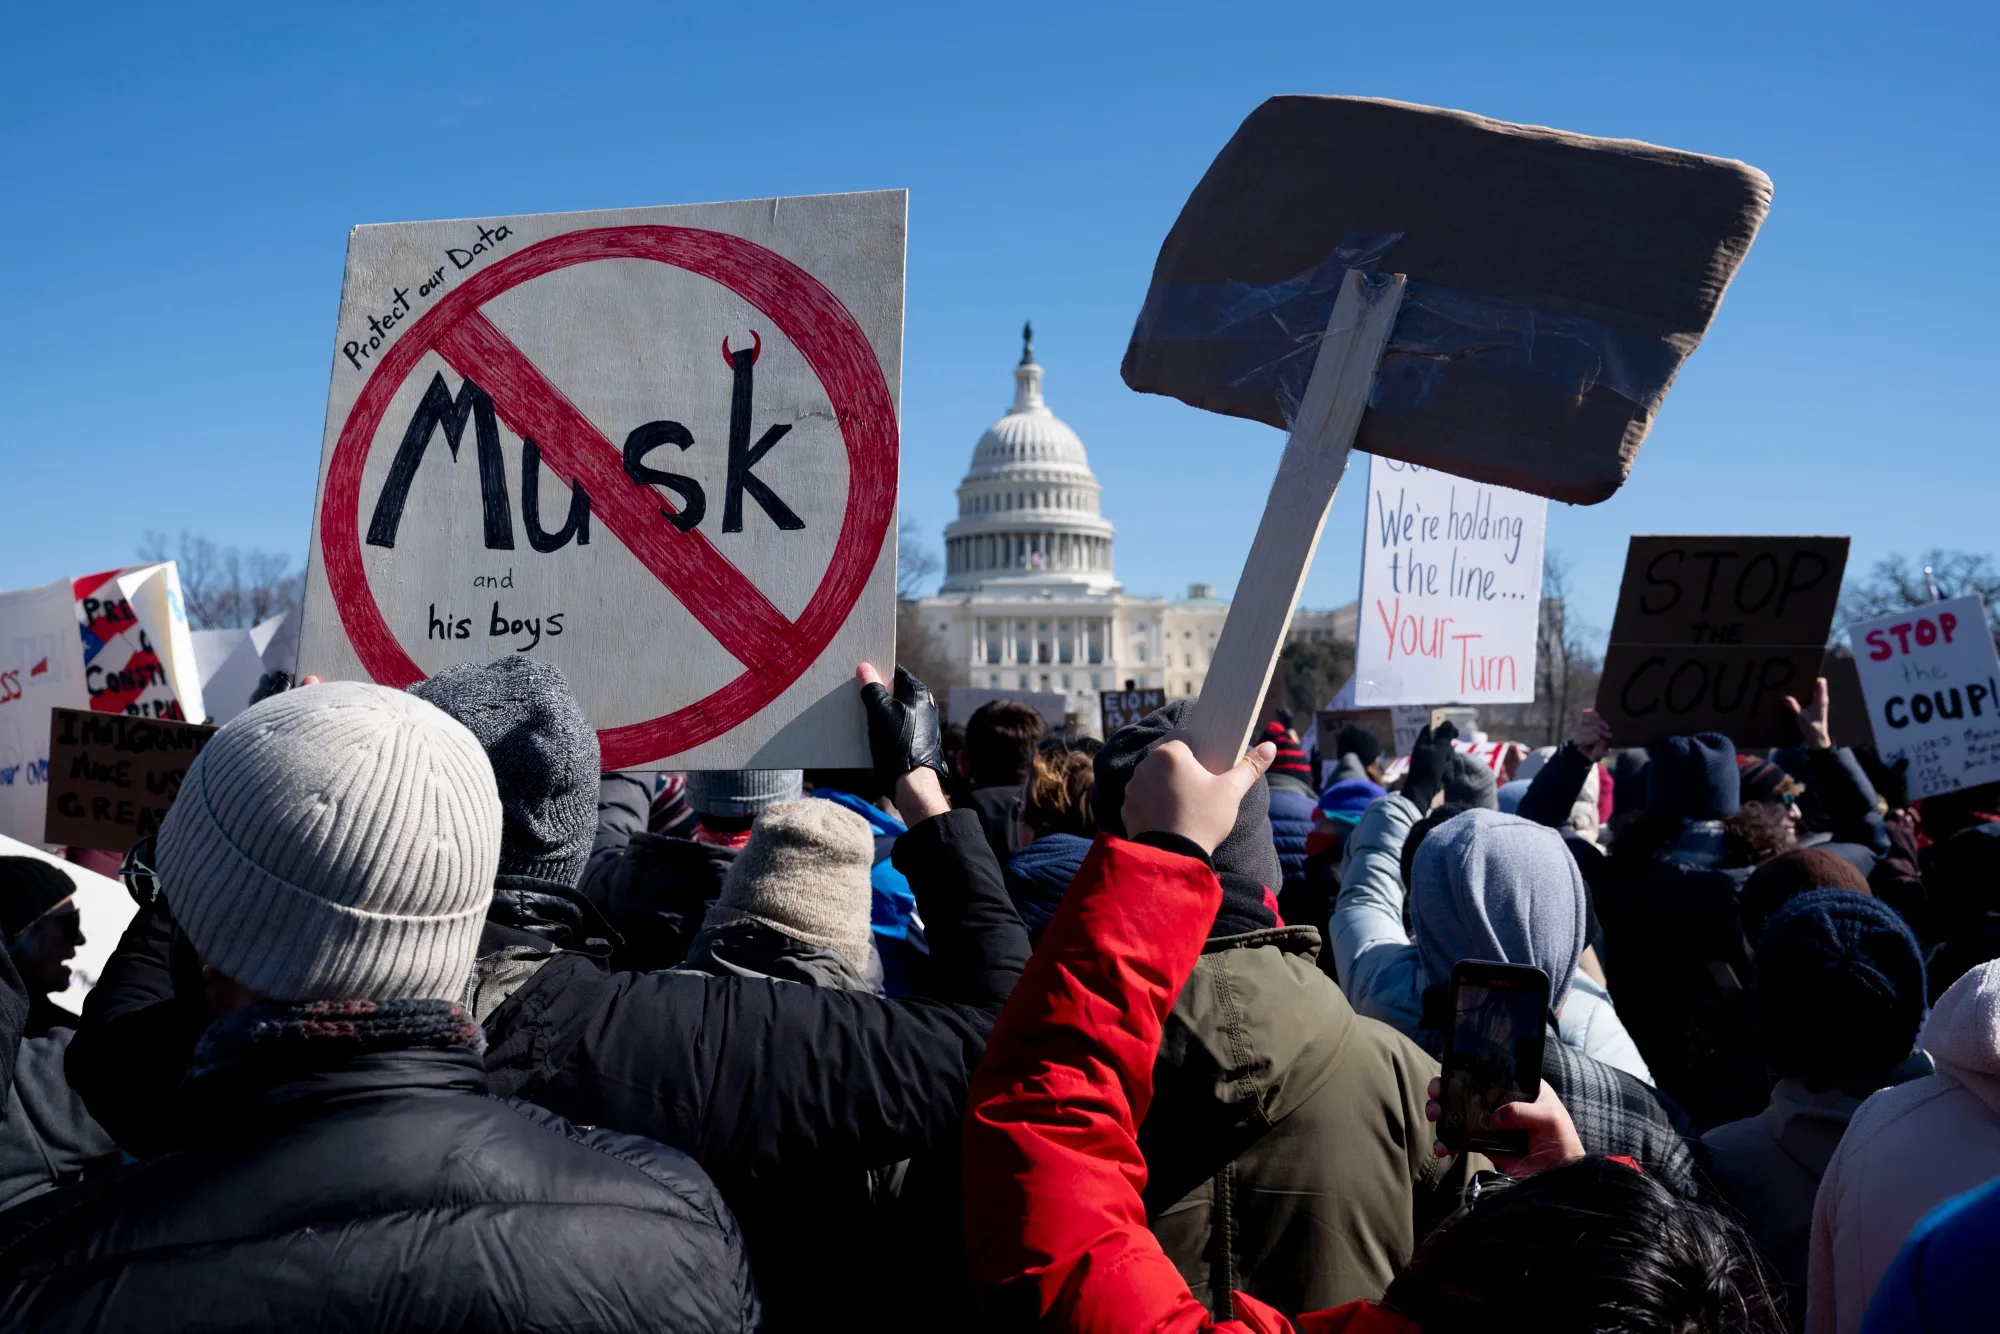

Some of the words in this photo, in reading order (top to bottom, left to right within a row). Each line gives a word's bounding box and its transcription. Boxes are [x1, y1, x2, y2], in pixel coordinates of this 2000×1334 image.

[342, 287, 411, 372] Protect
[418, 265, 445, 298] our
[445, 224, 514, 271] Data
[366, 346, 806, 553] Musk
[1376, 487, 1440, 549] We're
[1446, 485, 1523, 565] holding
[472, 567, 515, 590] and
[1387, 547, 1440, 597] the
[1449, 547, 1526, 601] line...
[1639, 548, 1829, 617] STOP
[427, 603, 473, 641] his
[488, 600, 565, 653] boys
[1376, 596, 1456, 661] Your
[1451, 634, 1517, 695] Turn
[1690, 622, 1745, 645] THE
[1865, 611, 1957, 662] STOP
[85, 662, 167, 697] CONSTI
[1620, 655, 1797, 718] COUP
[1900, 661, 1948, 685] the
[1883, 675, 2000, 730] COUP!
[56, 709, 213, 754] IMMIGRANT
[69, 751, 132, 788] MAKE
